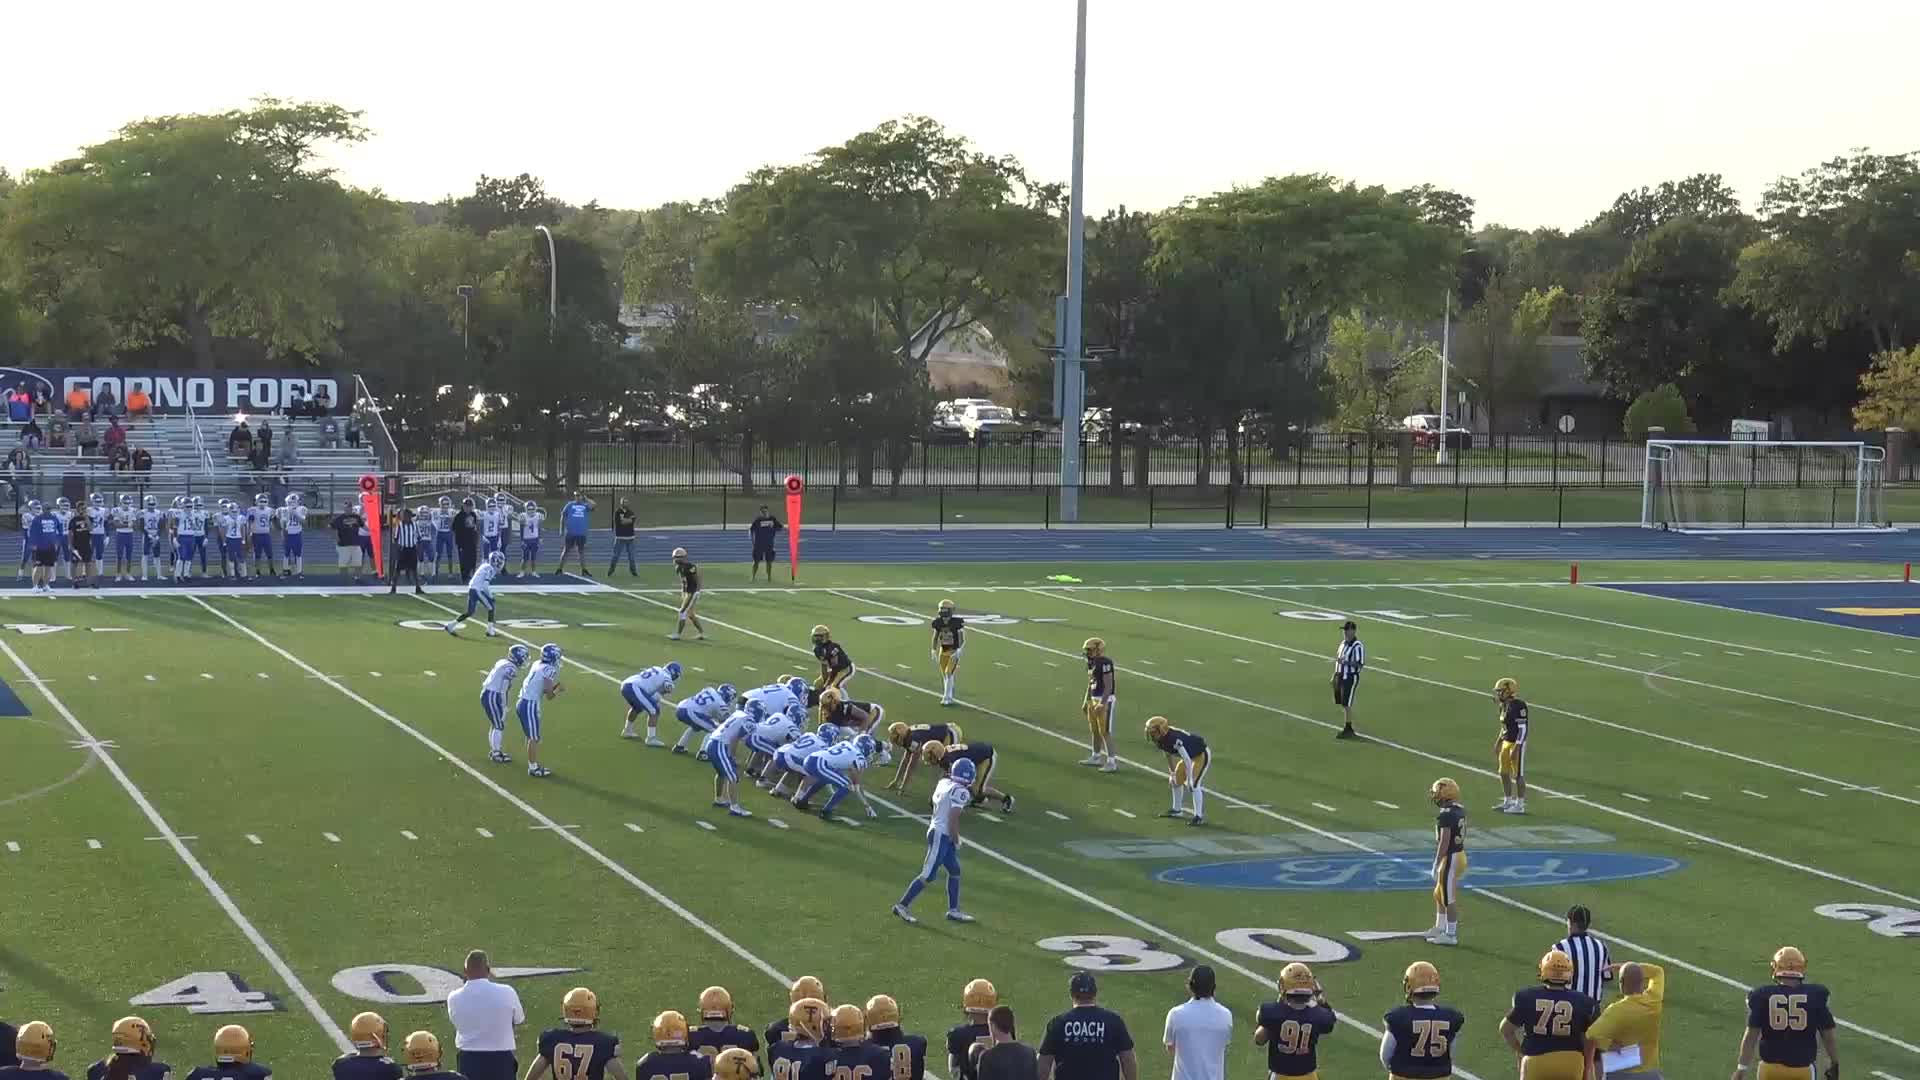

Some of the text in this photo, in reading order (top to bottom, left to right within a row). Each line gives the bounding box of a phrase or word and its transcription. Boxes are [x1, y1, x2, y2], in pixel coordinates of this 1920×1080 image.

[1064, 1021, 1105, 1038] COACH
[1535, 1000, 1574, 1036] 72
[1768, 994, 1808, 1031] 65
[1280, 1021, 1314, 1055] 91
[1412, 1021, 1450, 1057] 75
[553, 1042, 594, 1080] 67
